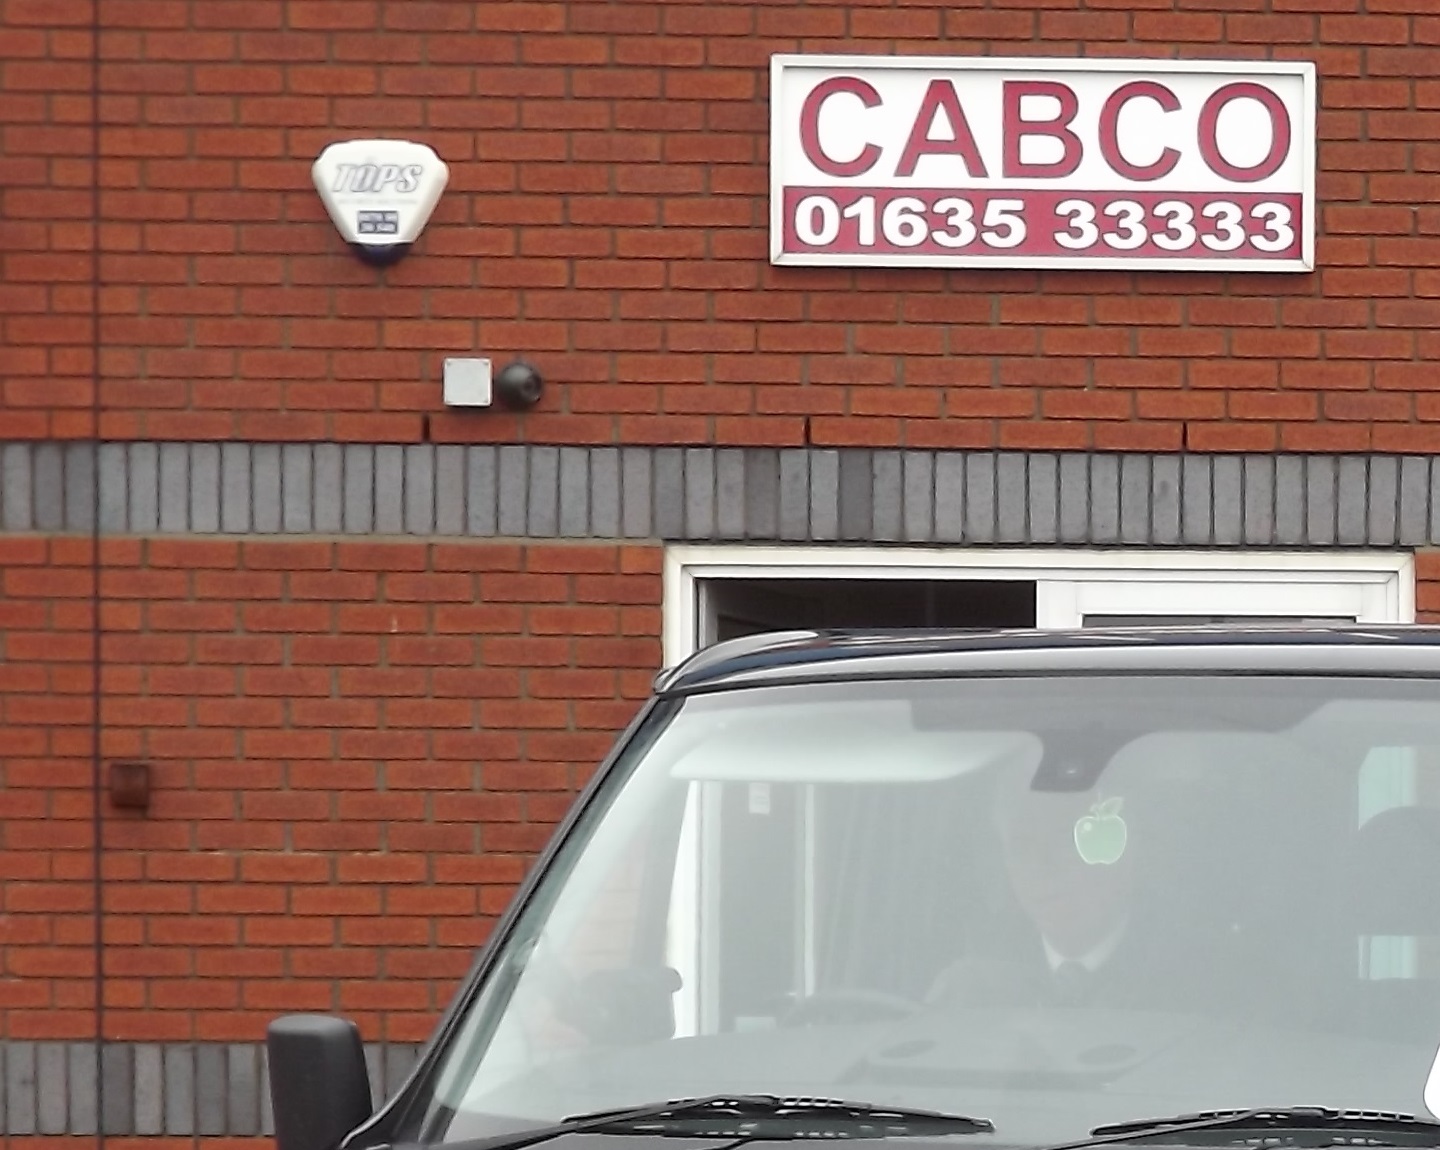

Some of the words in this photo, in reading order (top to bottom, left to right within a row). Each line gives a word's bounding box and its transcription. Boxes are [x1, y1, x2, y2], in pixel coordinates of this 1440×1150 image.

[799, 76, 1292, 183] CABCO
[333, 163, 423, 194] TOPS
[795, 195, 1028, 248] 01635
[1053, 199, 1295, 252] 33333
